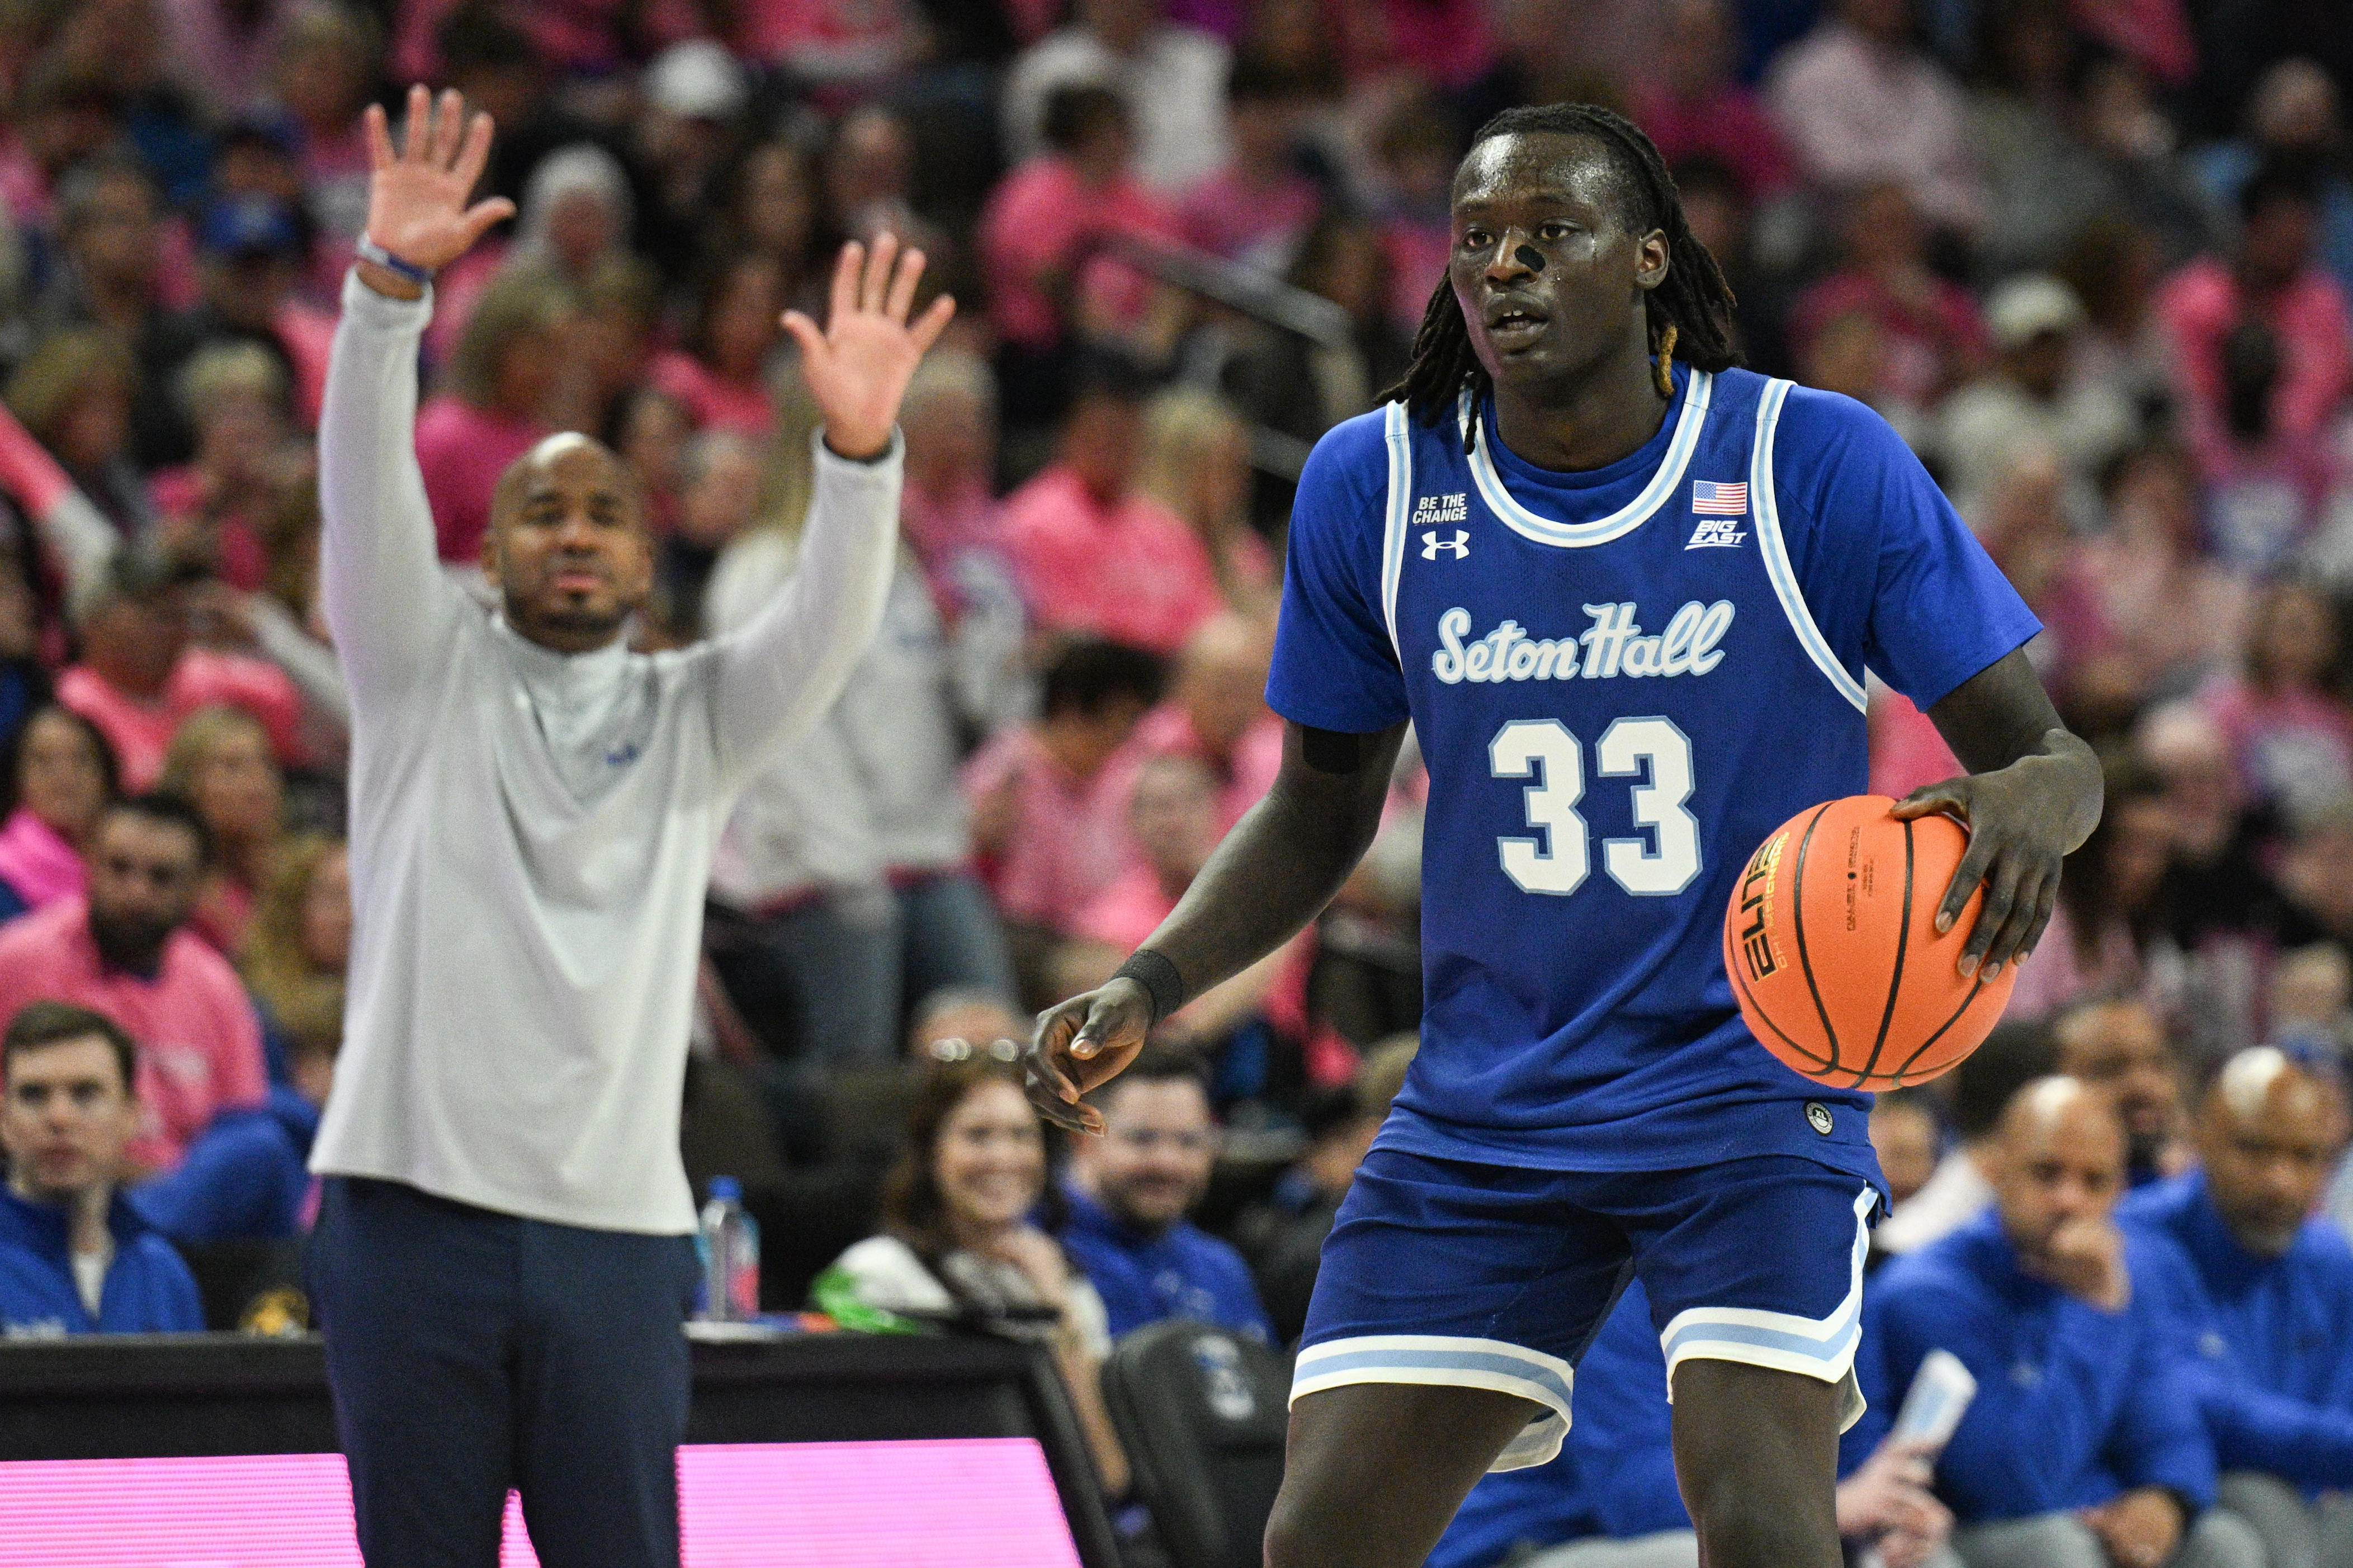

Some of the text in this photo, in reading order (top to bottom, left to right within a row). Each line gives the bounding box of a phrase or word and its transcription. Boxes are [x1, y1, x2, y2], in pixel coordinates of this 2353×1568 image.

[1418, 493, 1467, 510] BE THE
[1412, 506, 1468, 525] CHANGE
[1694, 519, 1738, 533] BIG
[1688, 531, 1748, 545] EAST
[1433, 599, 1736, 684] Seton Hall
[1488, 715, 1704, 896] 33
[1765, 831, 1790, 969] CHMPIONSHIP
[1741, 837, 1779, 983] ELITE
[1815, 1109, 1827, 1121] XL
